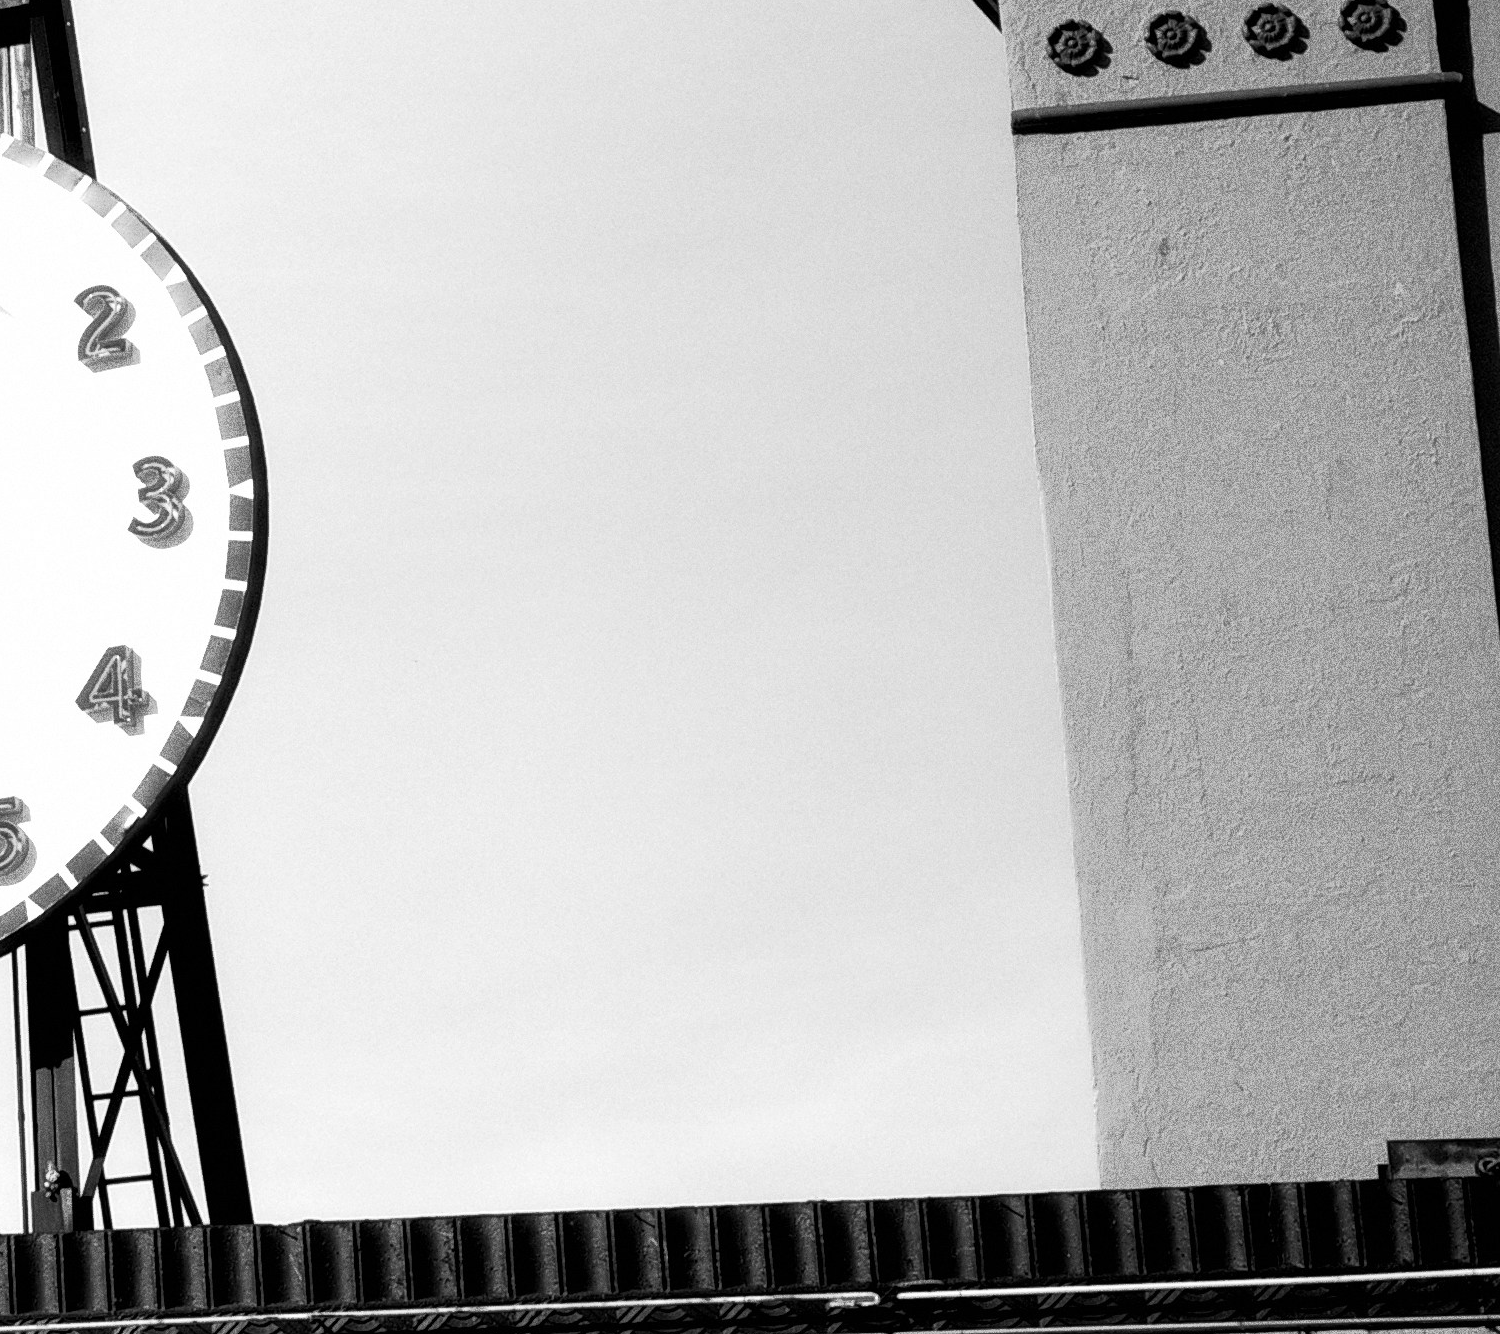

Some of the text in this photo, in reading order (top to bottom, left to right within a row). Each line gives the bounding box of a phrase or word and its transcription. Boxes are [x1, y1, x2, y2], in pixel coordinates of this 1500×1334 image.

[75, 286, 141, 373] 2
[128, 456, 193, 548] 3
[75, 645, 158, 736] 4
